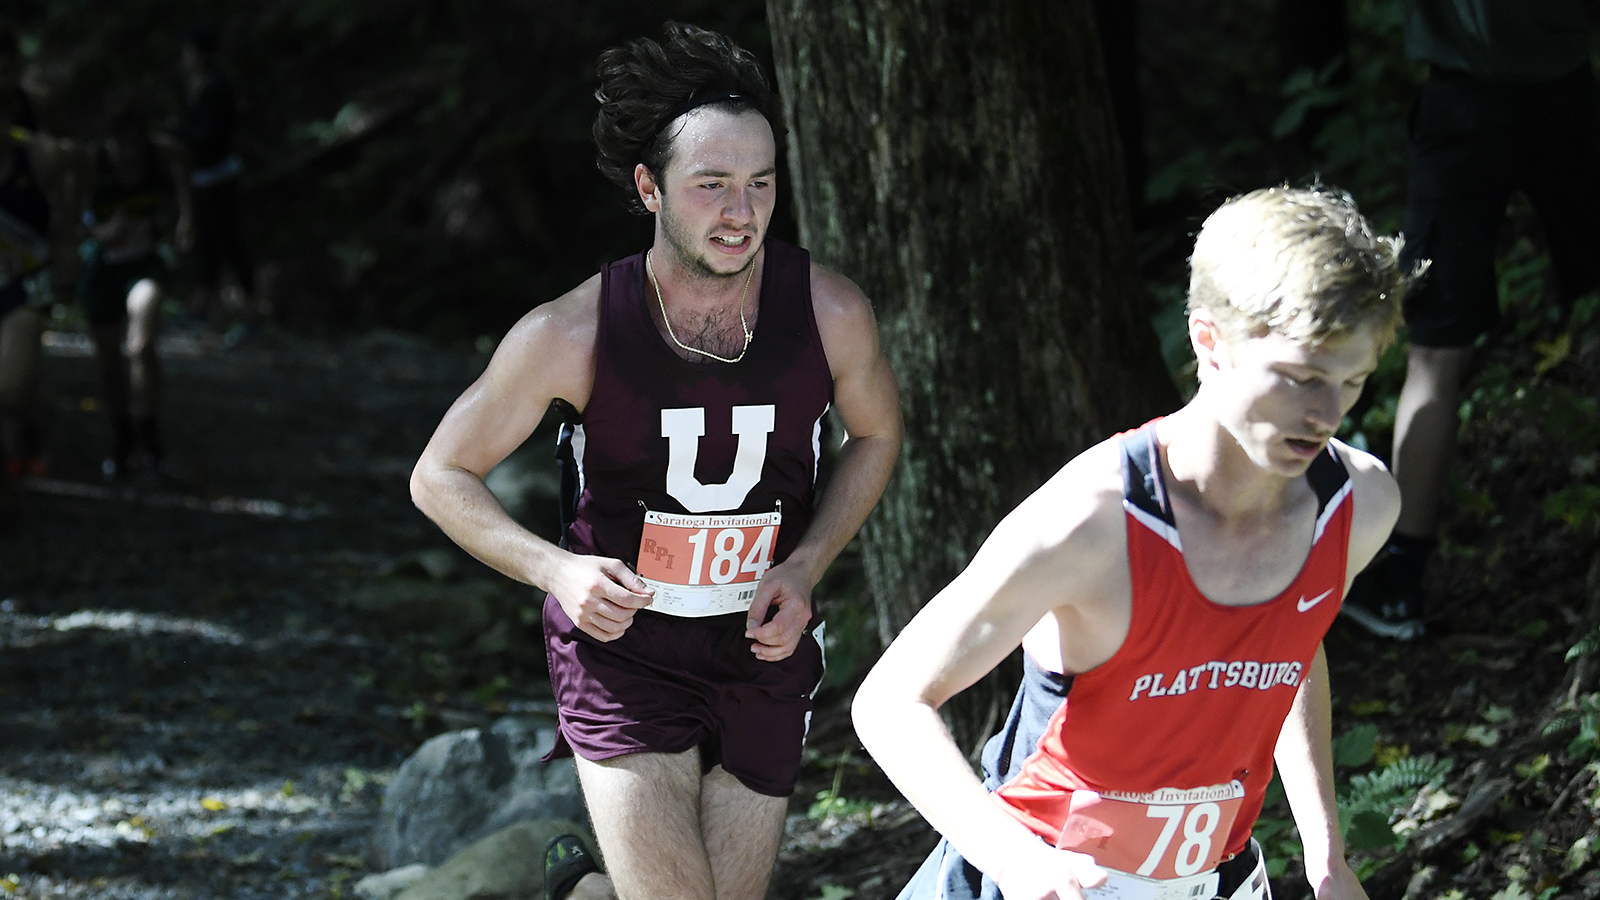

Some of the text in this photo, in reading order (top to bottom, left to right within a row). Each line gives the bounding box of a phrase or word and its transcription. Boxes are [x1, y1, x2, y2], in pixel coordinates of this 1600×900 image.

[660, 404, 776, 514] U
[655, 513, 773, 529] Saratoga Invitational
[643, 537, 675, 570] RPI
[688, 526, 774, 586] 184
[1129, 660, 1303, 702] PLATTSBURG
[1160, 784, 1234, 801] Invitational
[1135, 802, 1221, 877] 78
